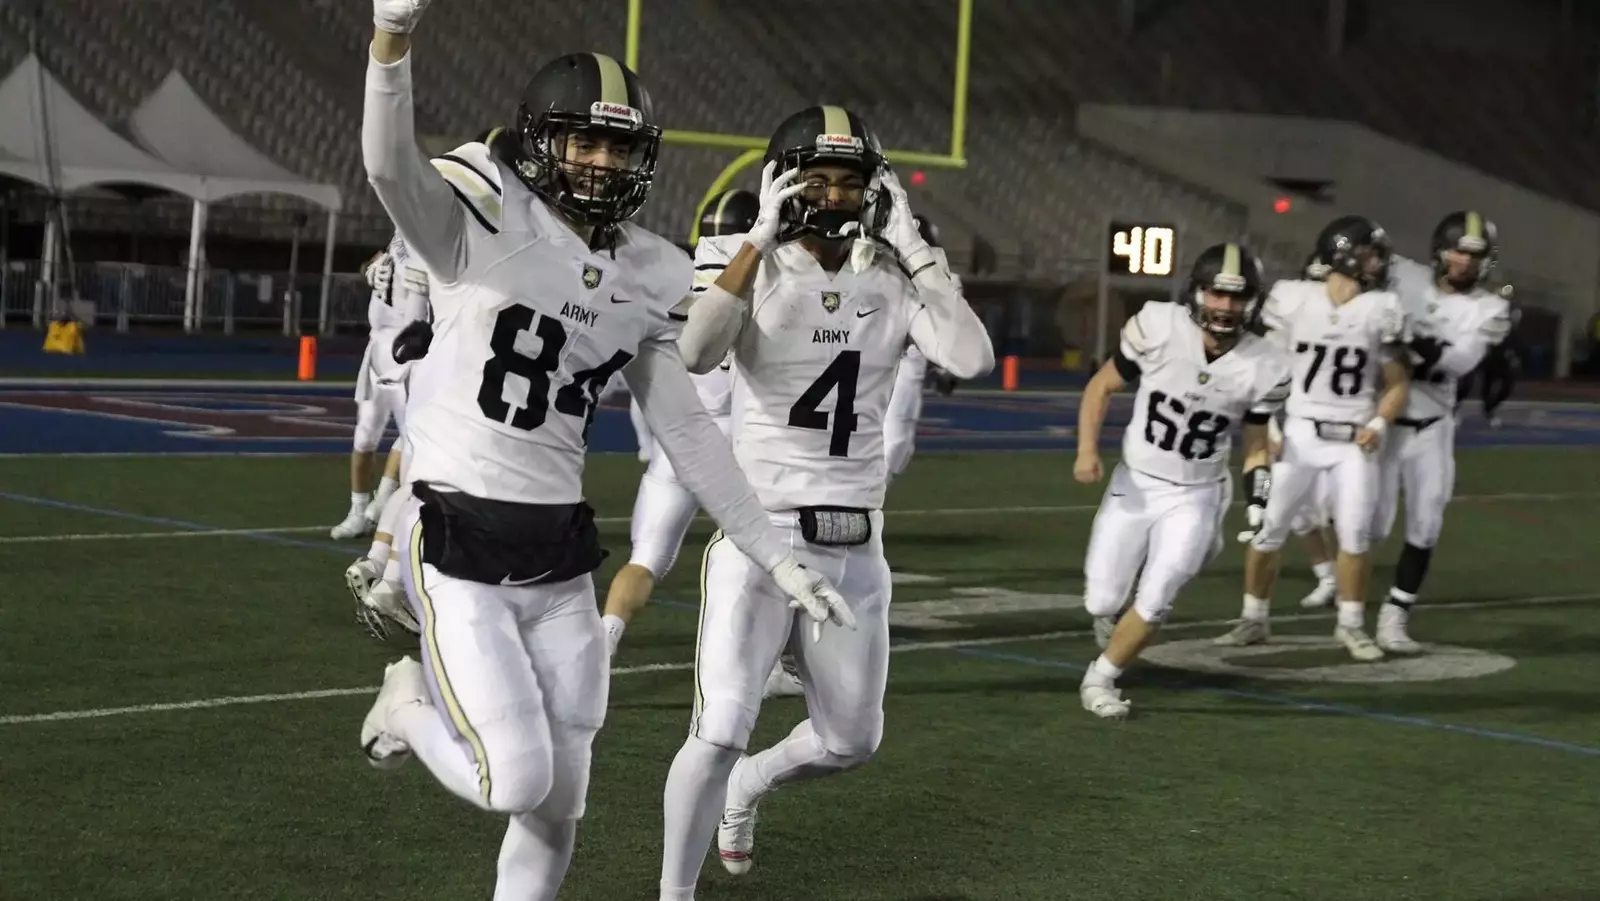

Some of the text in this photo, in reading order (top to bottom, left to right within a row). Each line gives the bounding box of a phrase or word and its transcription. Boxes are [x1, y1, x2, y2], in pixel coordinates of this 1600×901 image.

[603, 104, 631, 116] Riddell
[1113, 226, 1173, 275] 40
[560, 301, 599, 328] ARMY
[812, 329, 850, 344] ARMY
[477, 303, 634, 434] 84
[1296, 341, 1368, 396] 78
[787, 349, 861, 457] 4
[1145, 390, 1230, 460] 68
